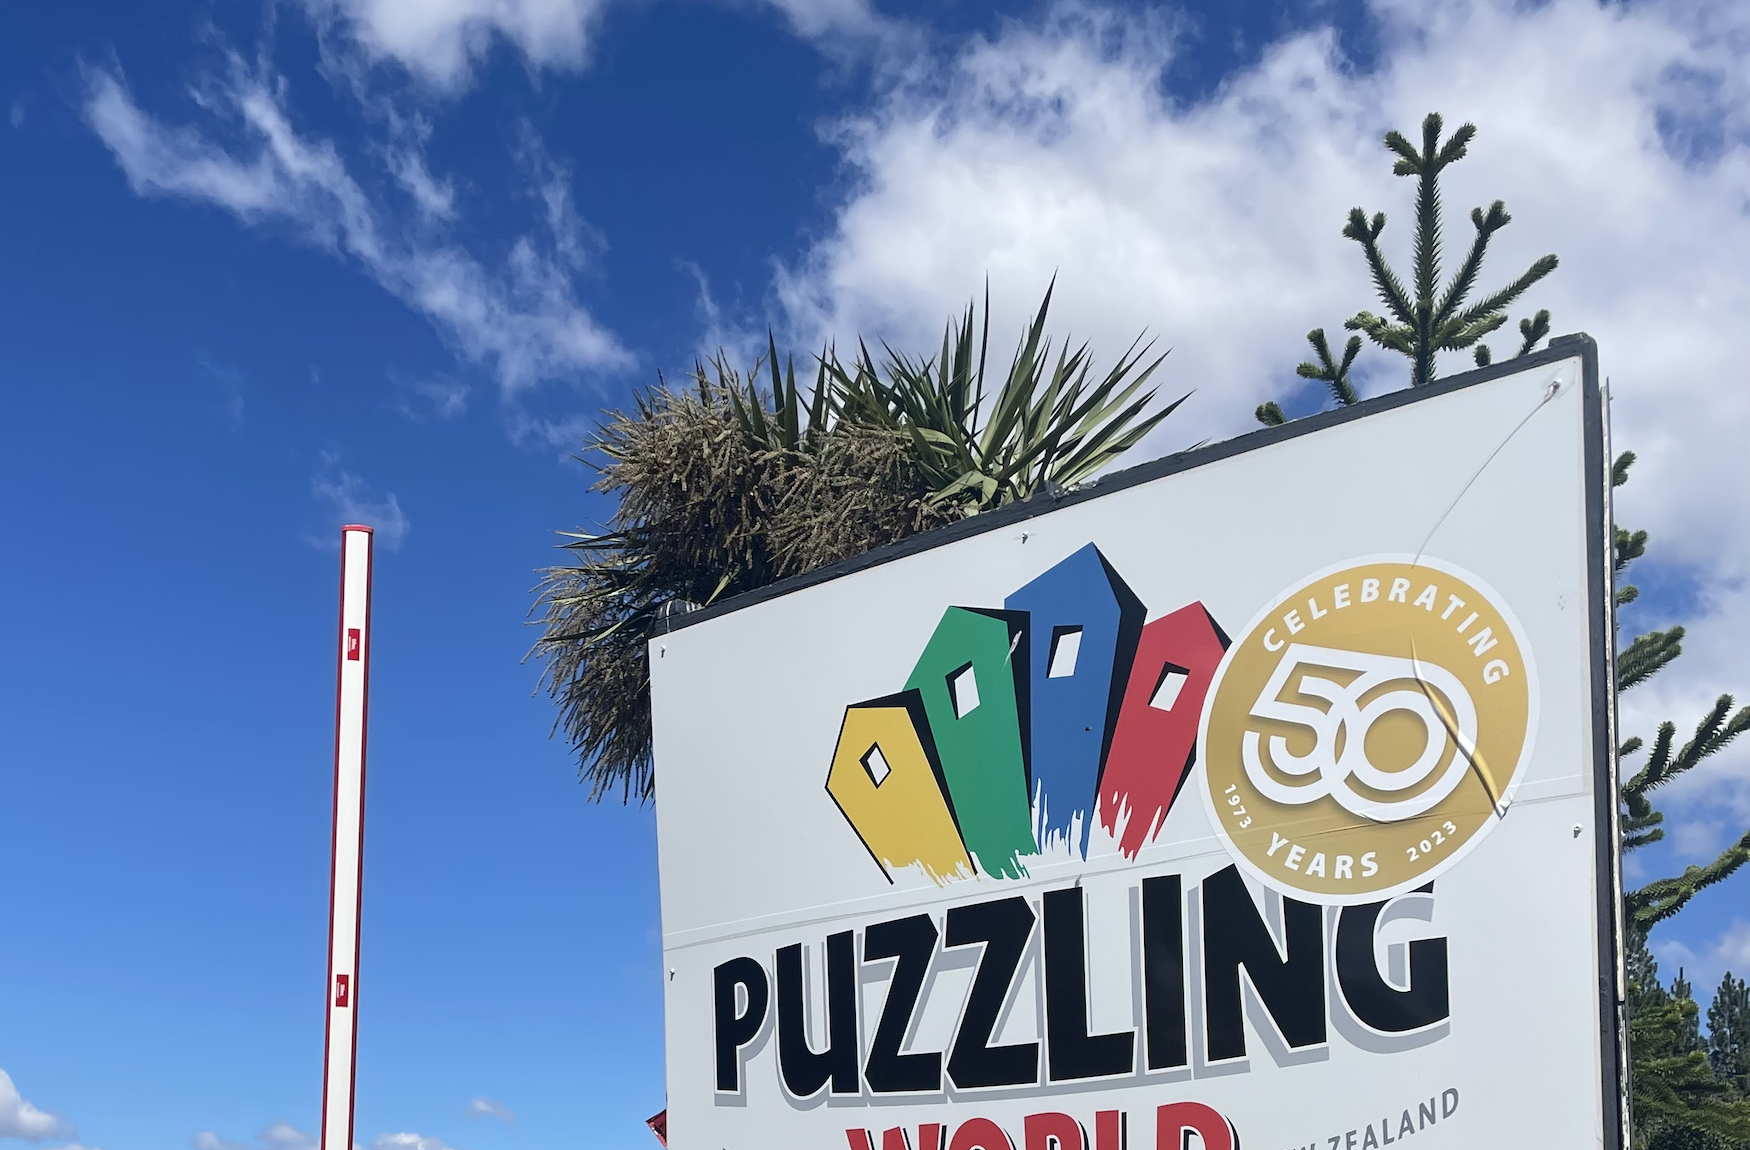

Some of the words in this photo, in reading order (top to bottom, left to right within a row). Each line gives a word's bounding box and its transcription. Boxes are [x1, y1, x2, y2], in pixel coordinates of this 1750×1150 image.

[1263, 577, 1510, 686] CELEBRATING
[1242, 643, 1478, 822] 50
[1224, 783, 1253, 830] 1973
[1406, 820, 1458, 863] 2023
[1265, 832, 1379, 880] YEARS
[712, 864, 1450, 1102] PUZZLING
